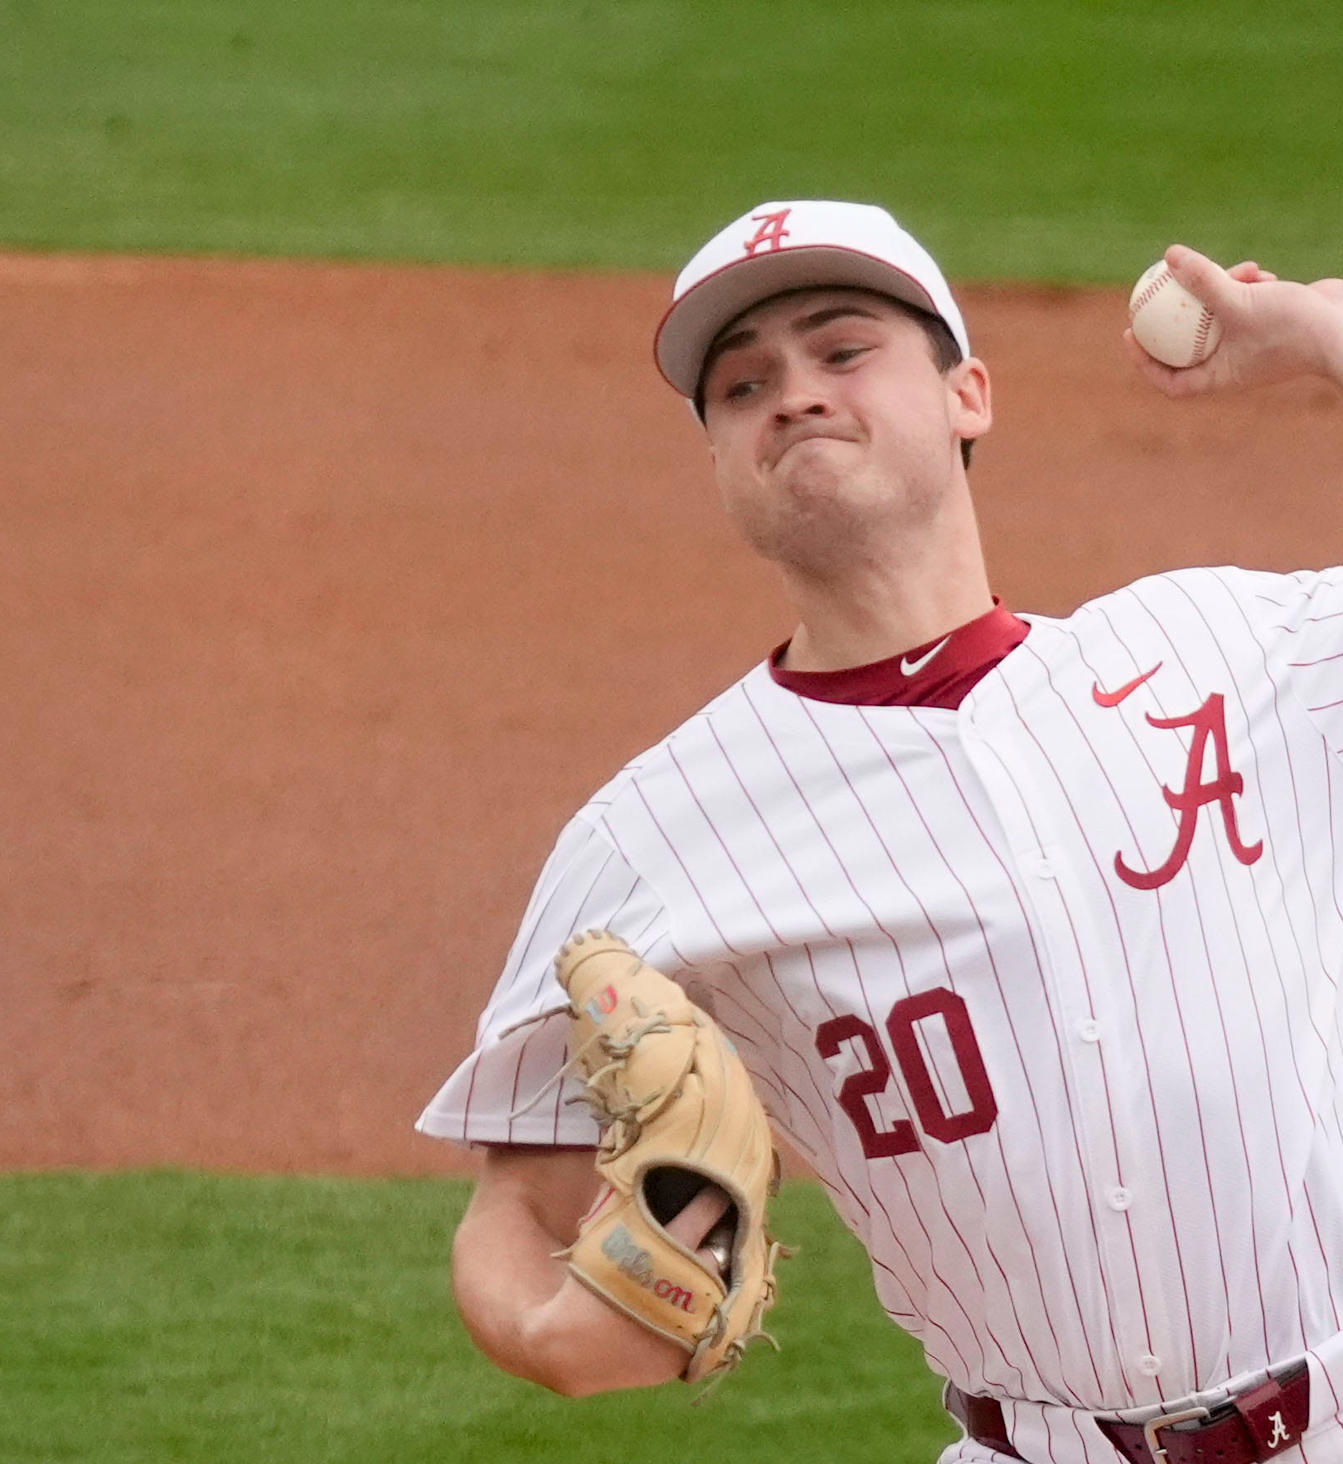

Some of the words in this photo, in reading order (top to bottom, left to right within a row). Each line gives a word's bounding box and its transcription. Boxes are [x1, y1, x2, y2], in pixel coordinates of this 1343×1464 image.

[744, 208, 792, 257] A
[1114, 692, 1263, 890] A
[814, 986, 998, 1159] 20
[1267, 1410, 1290, 1449] A
